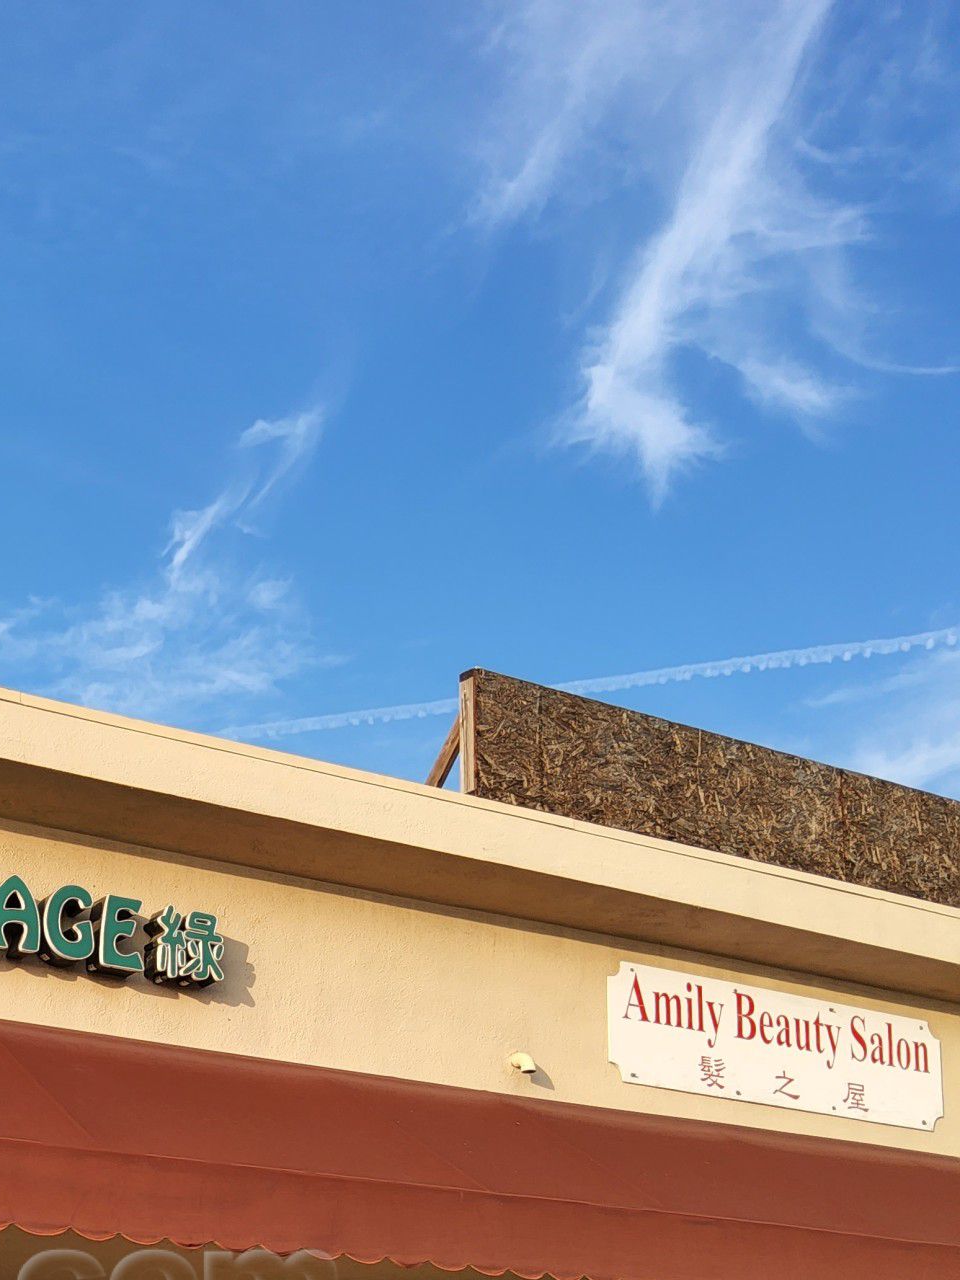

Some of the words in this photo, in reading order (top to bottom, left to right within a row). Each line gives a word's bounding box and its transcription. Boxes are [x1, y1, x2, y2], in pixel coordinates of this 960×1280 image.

[622, 973, 725, 1049] Amily
[733, 991, 842, 1070] Beauty
[850, 1015, 931, 1074] Salon
